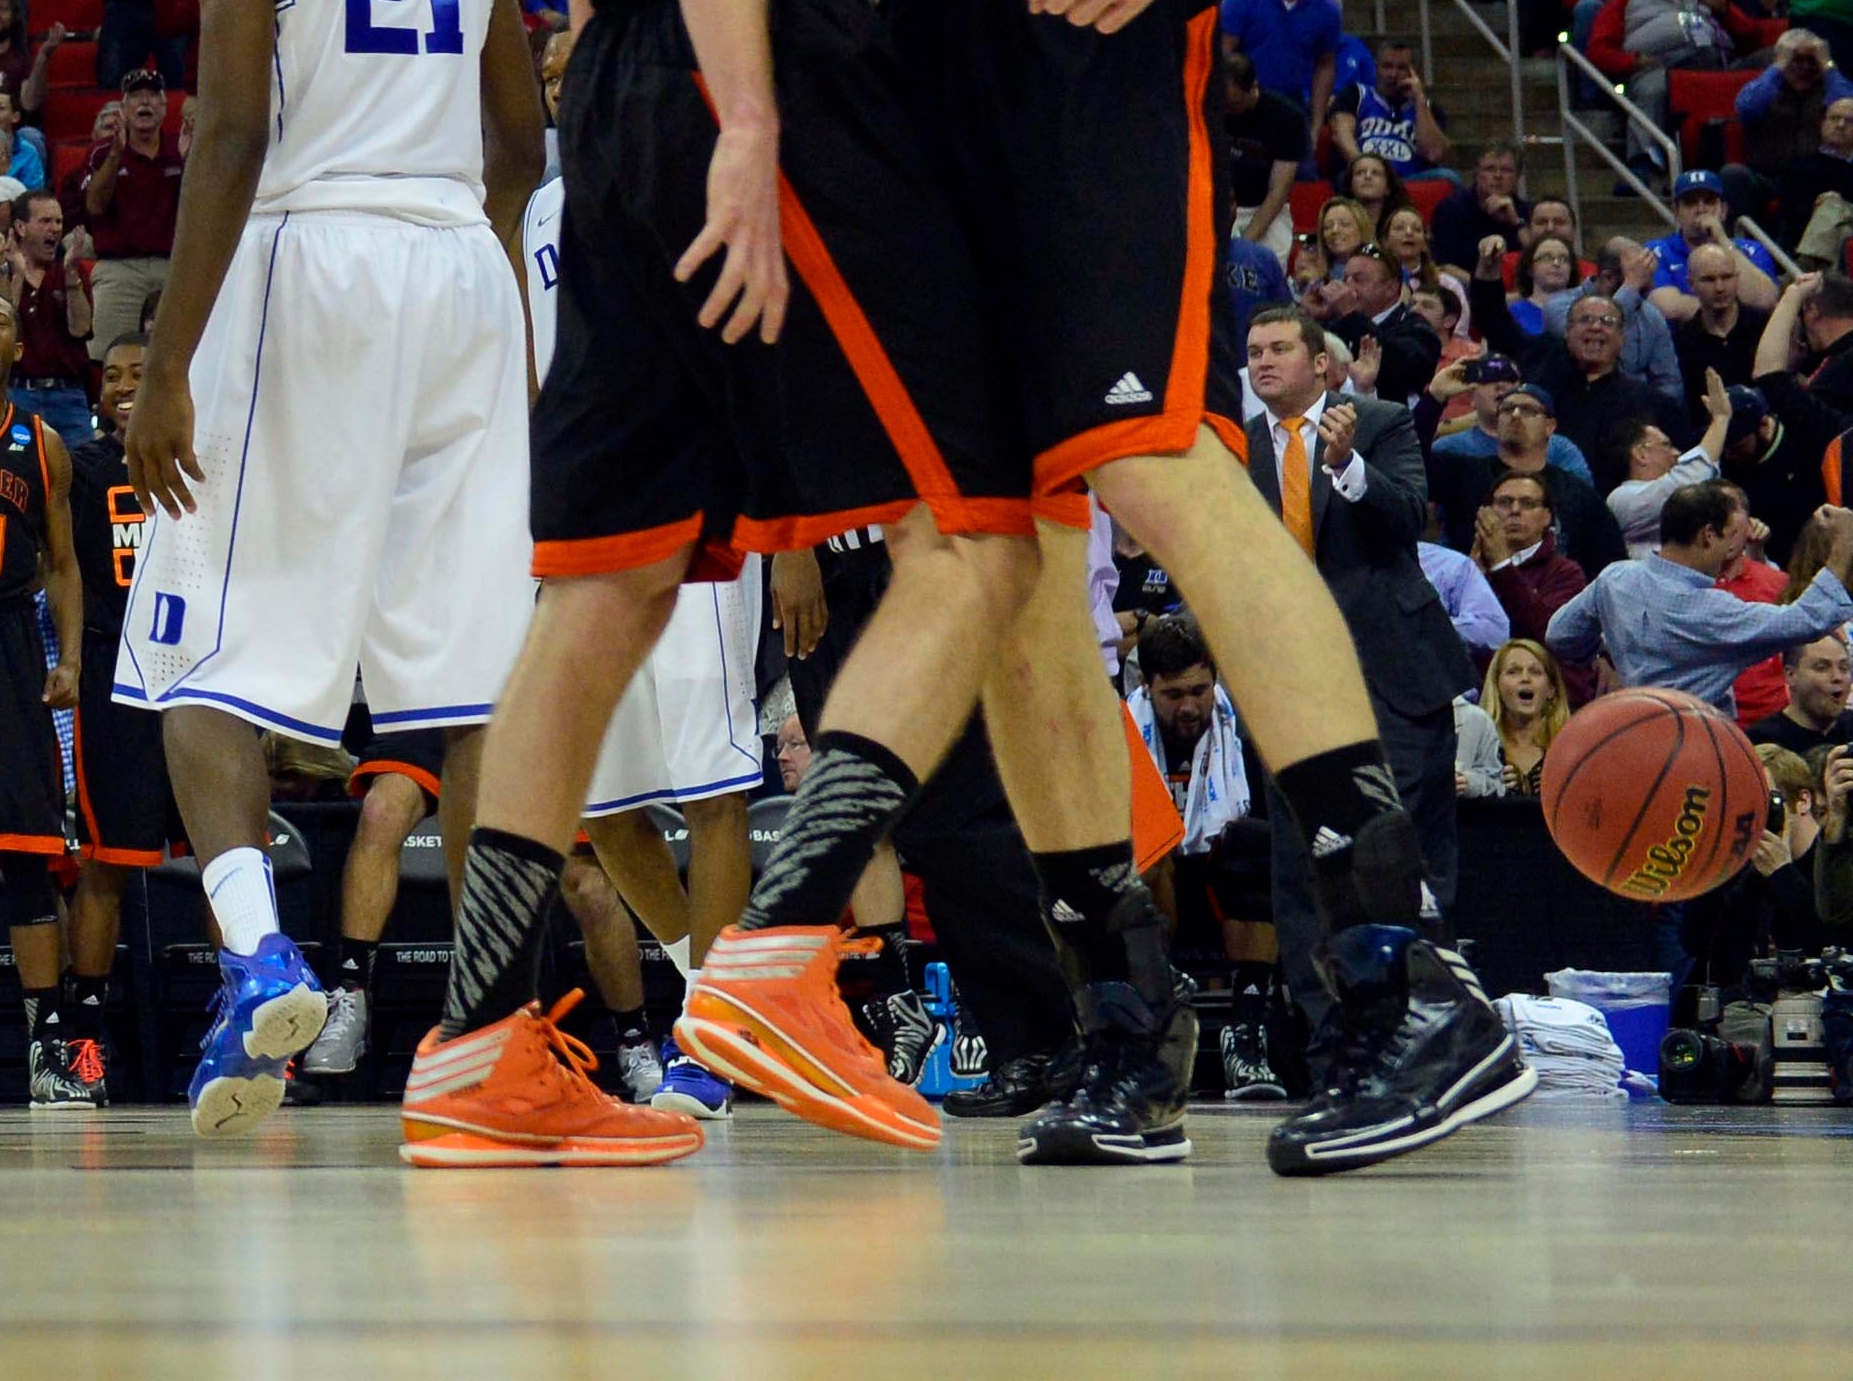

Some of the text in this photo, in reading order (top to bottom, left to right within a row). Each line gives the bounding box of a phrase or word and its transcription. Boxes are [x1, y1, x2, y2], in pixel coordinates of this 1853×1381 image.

[1623, 784, 1711, 901] Wilson
[396, 951, 449, 963] THE ROAD TO
